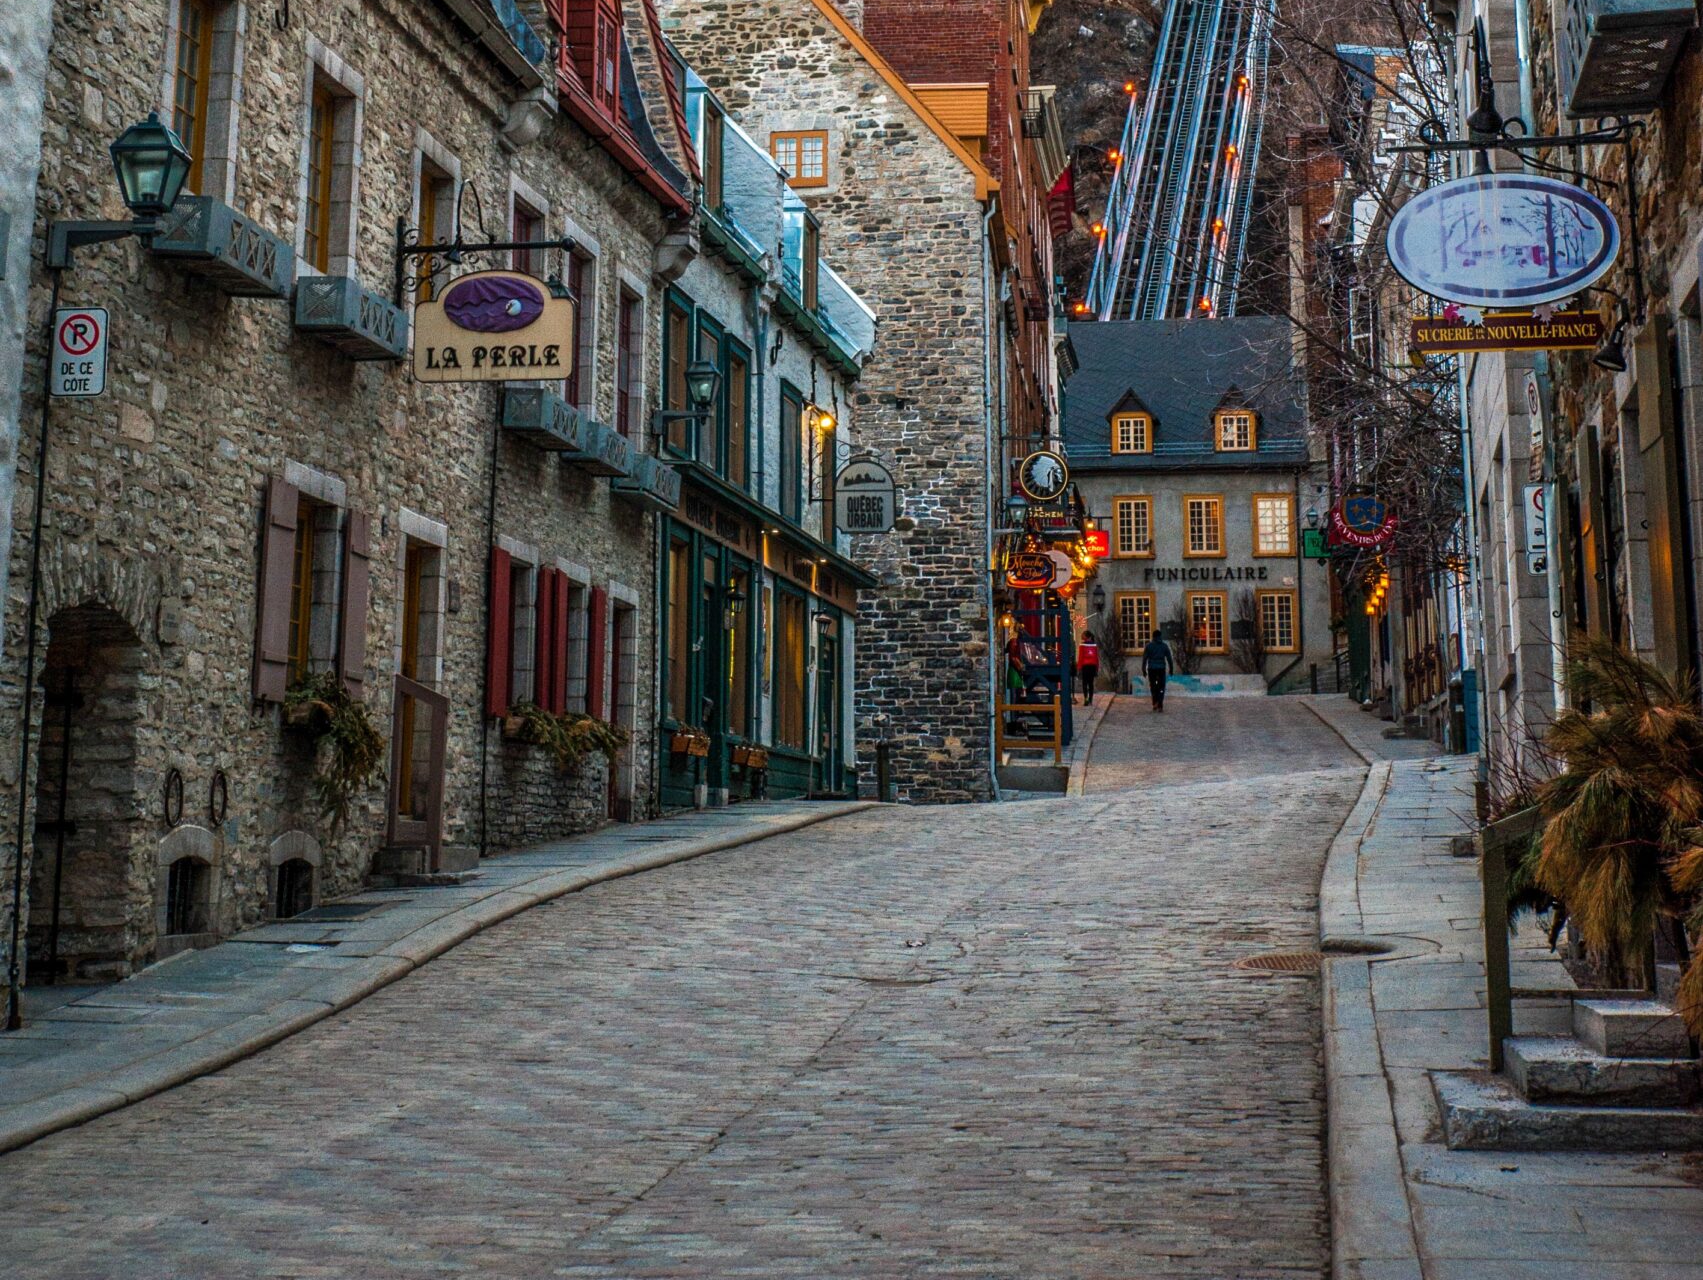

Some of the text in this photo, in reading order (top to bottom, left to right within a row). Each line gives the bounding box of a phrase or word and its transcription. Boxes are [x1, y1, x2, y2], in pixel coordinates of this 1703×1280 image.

[1417, 327, 1475, 343] SUCRERIE
[1487, 323, 1597, 340] NOUVELLE-FRANCE
[426, 345, 561, 369] LA PERLE
[61, 361, 94, 375] DE CE
[847, 512, 883, 528] URBAIN
[1143, 566, 1268, 582] FUNICULAIRE
